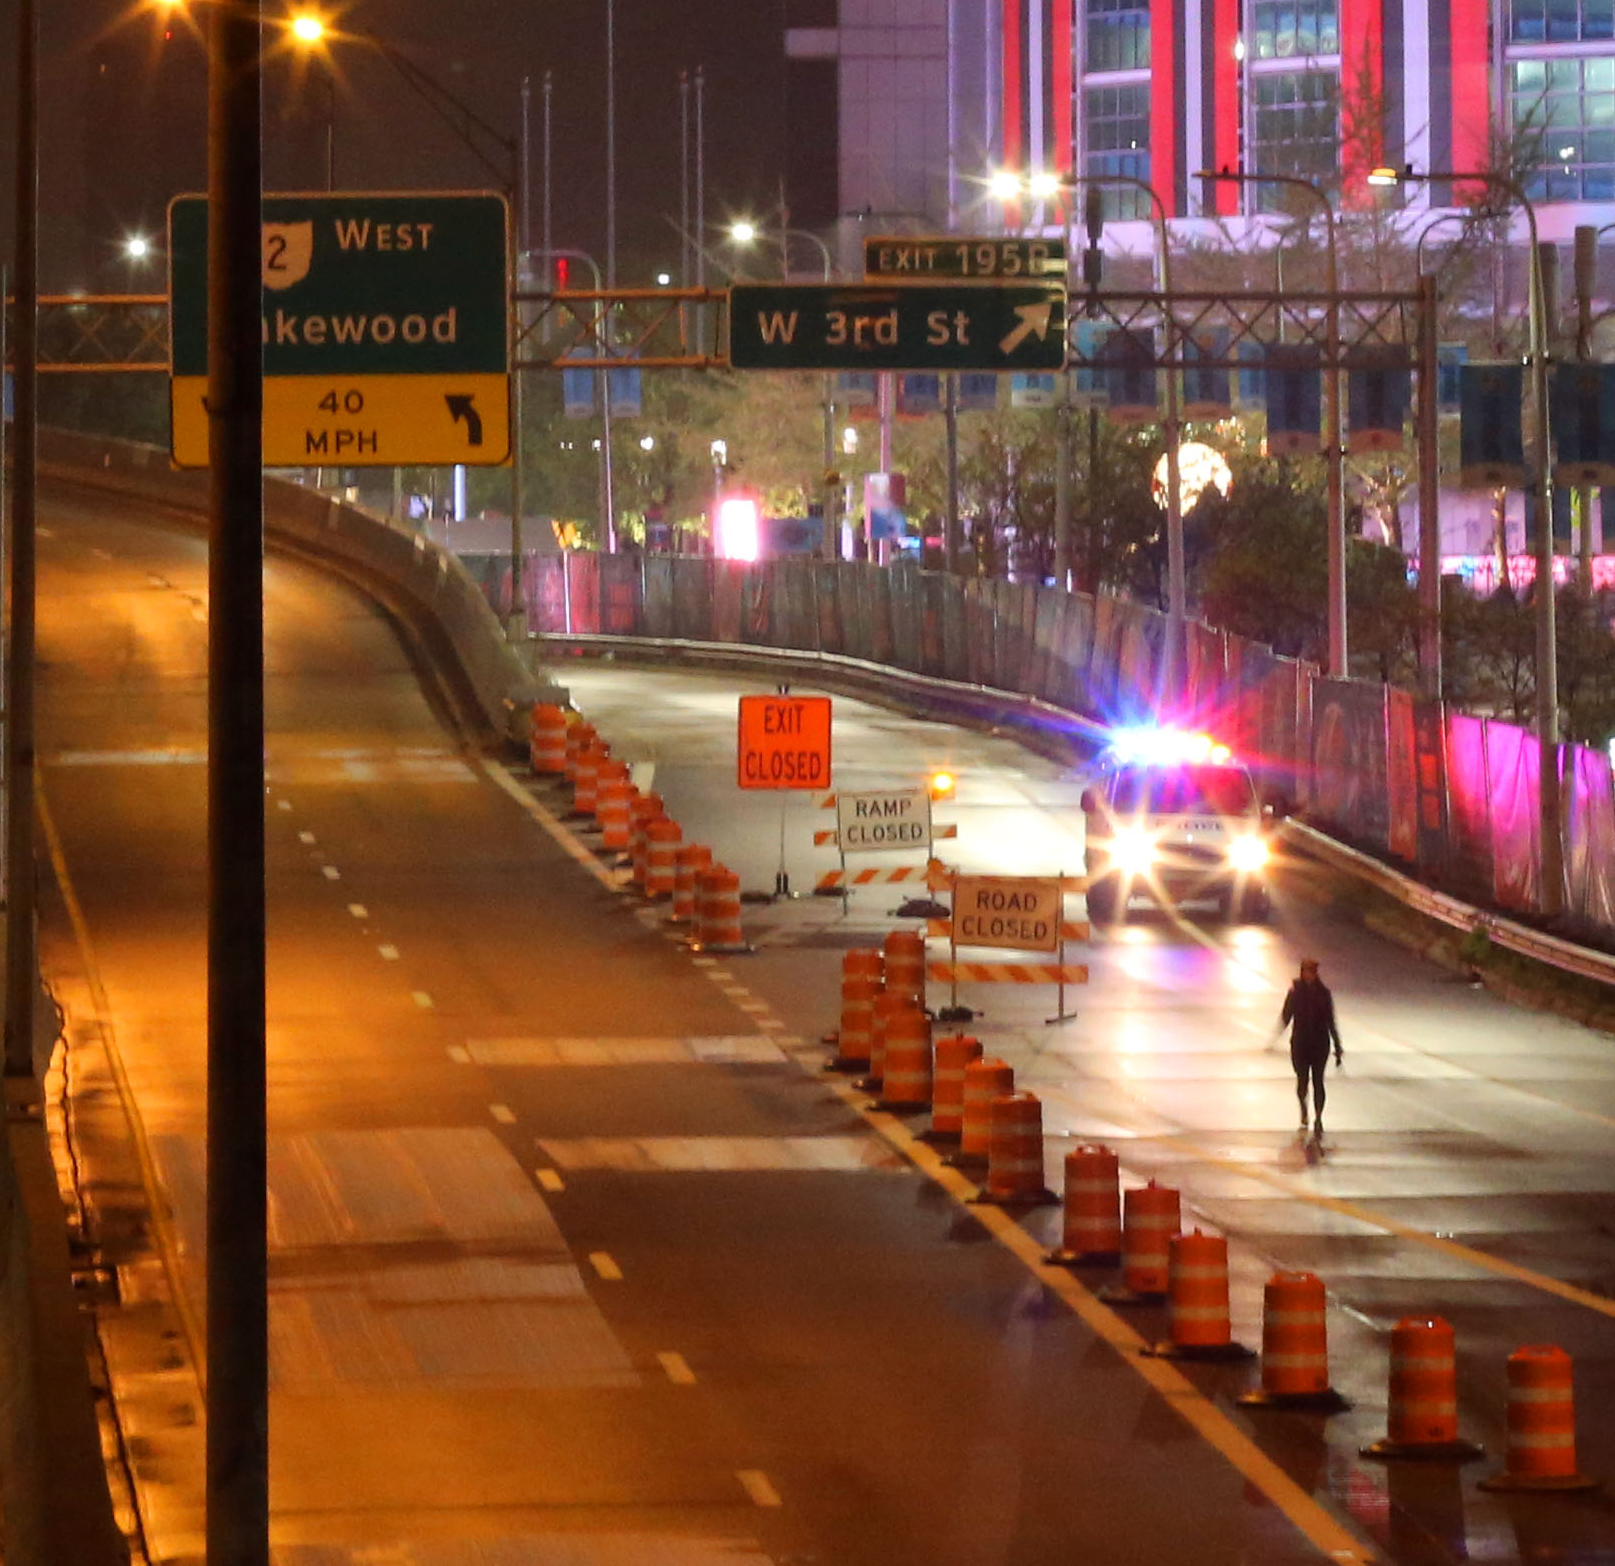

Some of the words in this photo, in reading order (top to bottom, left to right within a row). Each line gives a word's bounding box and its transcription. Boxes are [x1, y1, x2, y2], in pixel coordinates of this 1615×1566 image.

[335, 219, 434, 251] WEST
[879, 247, 940, 270] EXIT
[261, 306, 457, 345] kewood
[758, 311, 799, 345] W
[826, 308, 899, 346] 3rd
[927, 310, 970, 346] St
[318, 390, 364, 414] 40
[306, 430, 378, 454] MPH
[764, 705, 804, 734] EXIT
[746, 751, 822, 781] CLOSED
[856, 799, 912, 818] RAMP
[847, 822, 923, 844] CLOSED
[977, 889, 1037, 911] ROAD
[962, 917, 1048, 941] CLOSED
